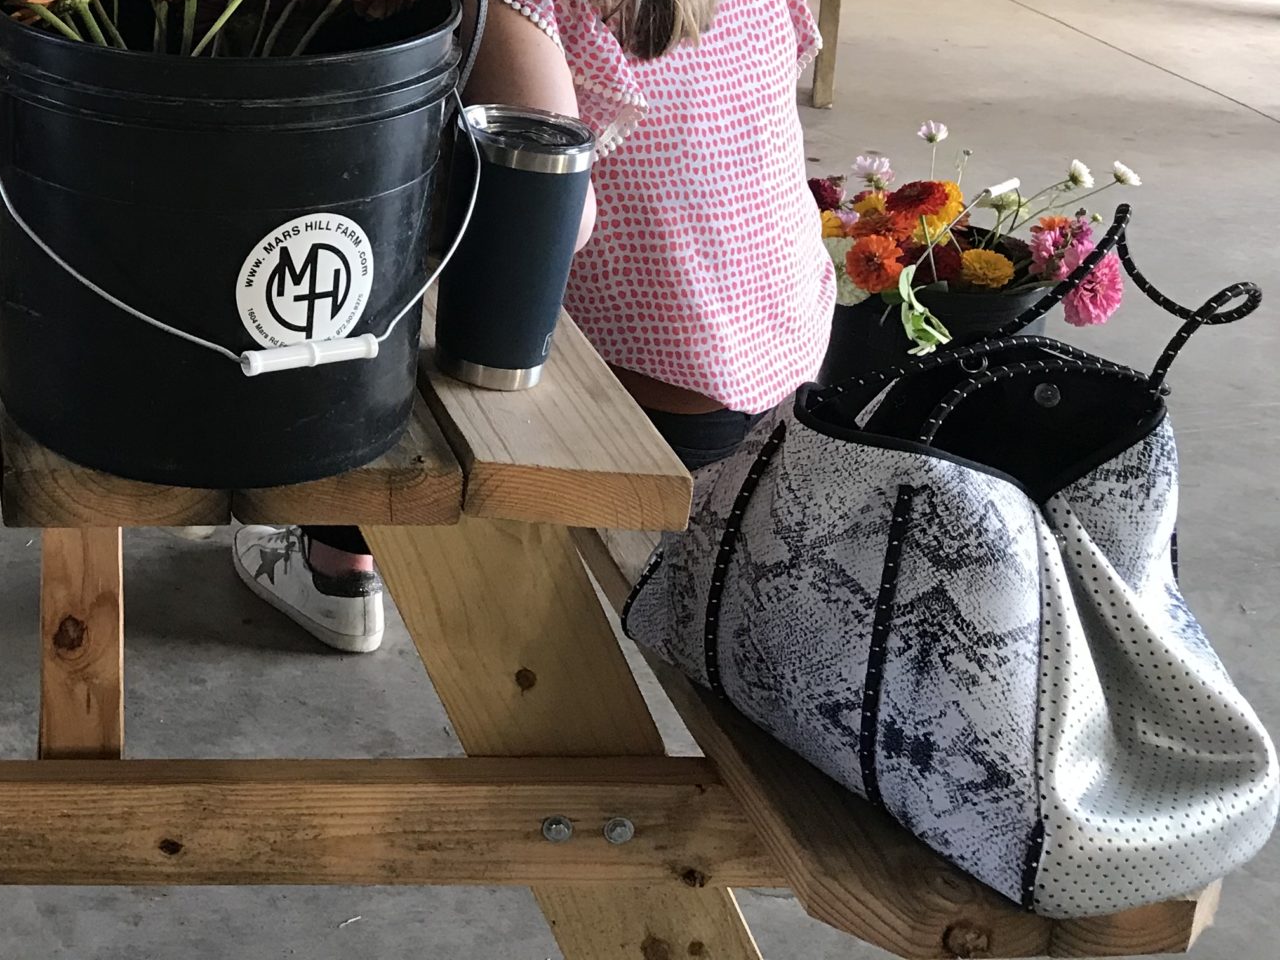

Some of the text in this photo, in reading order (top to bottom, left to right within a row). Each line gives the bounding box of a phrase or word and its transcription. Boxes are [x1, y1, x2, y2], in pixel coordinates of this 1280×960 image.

[263, 225, 301, 255] MARS
[305, 220, 332, 232] HILL
[335, 223, 362, 248] FARM
[255, 323, 269, 339] Mars
